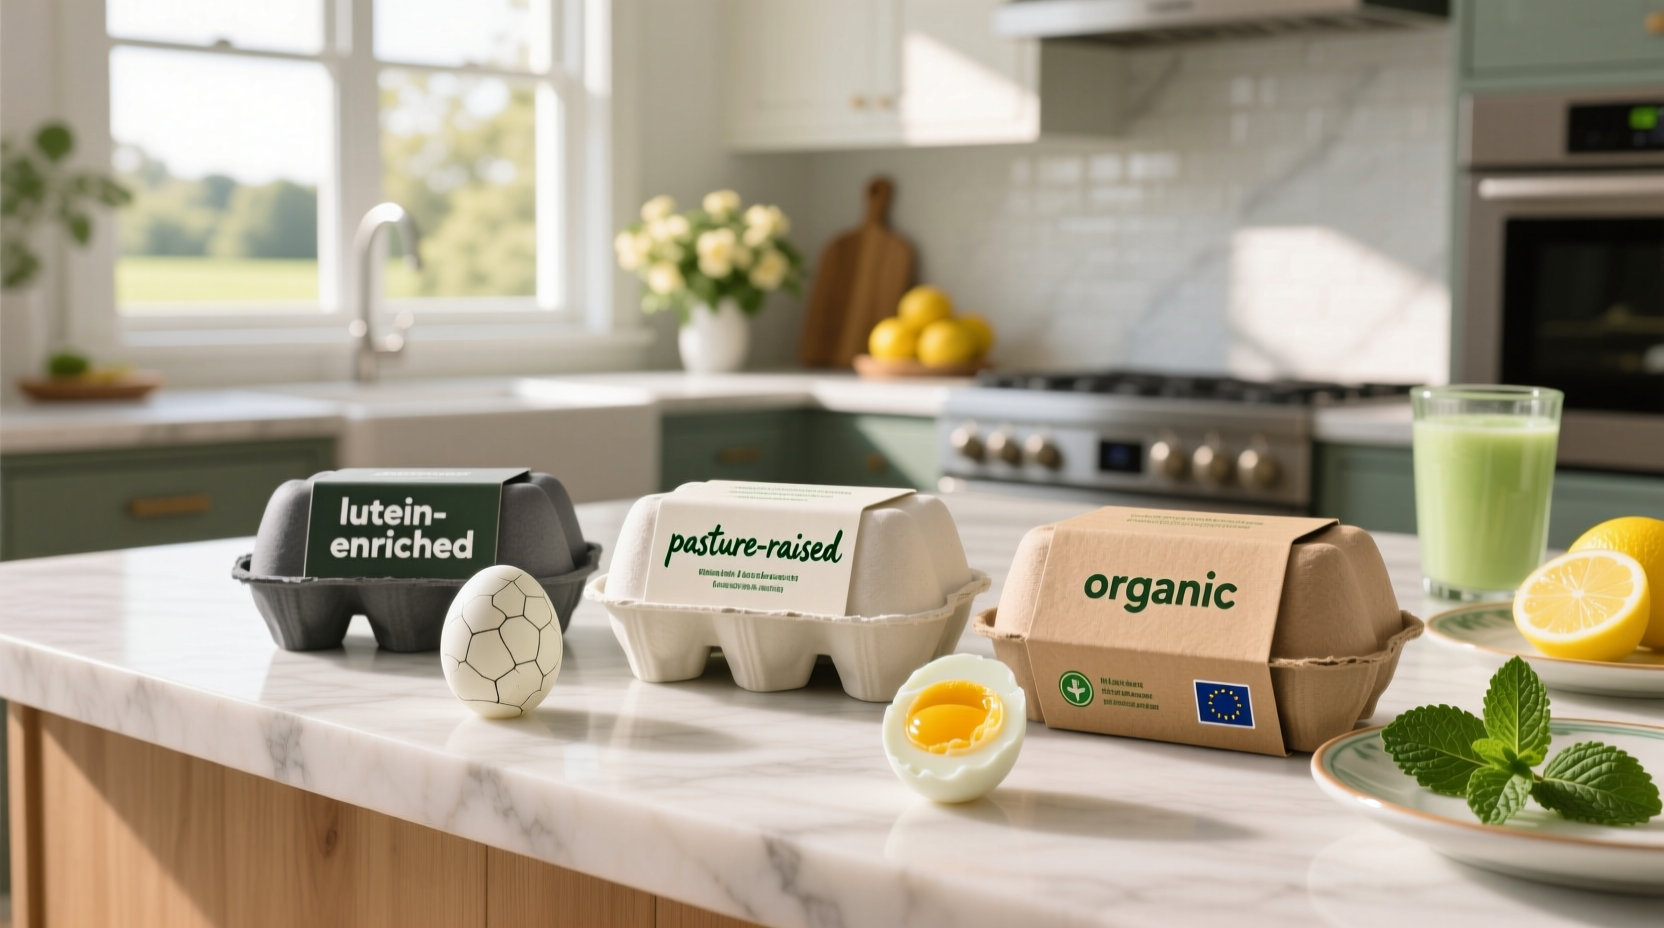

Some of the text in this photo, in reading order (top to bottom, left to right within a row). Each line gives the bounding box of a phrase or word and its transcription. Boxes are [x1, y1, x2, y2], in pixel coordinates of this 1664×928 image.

[340, 496, 447, 526] lutein-
[330, 529, 475, 559] enriched
[664, 524, 843, 568] pasture-raised
[1084, 570, 1238, 614] organic
